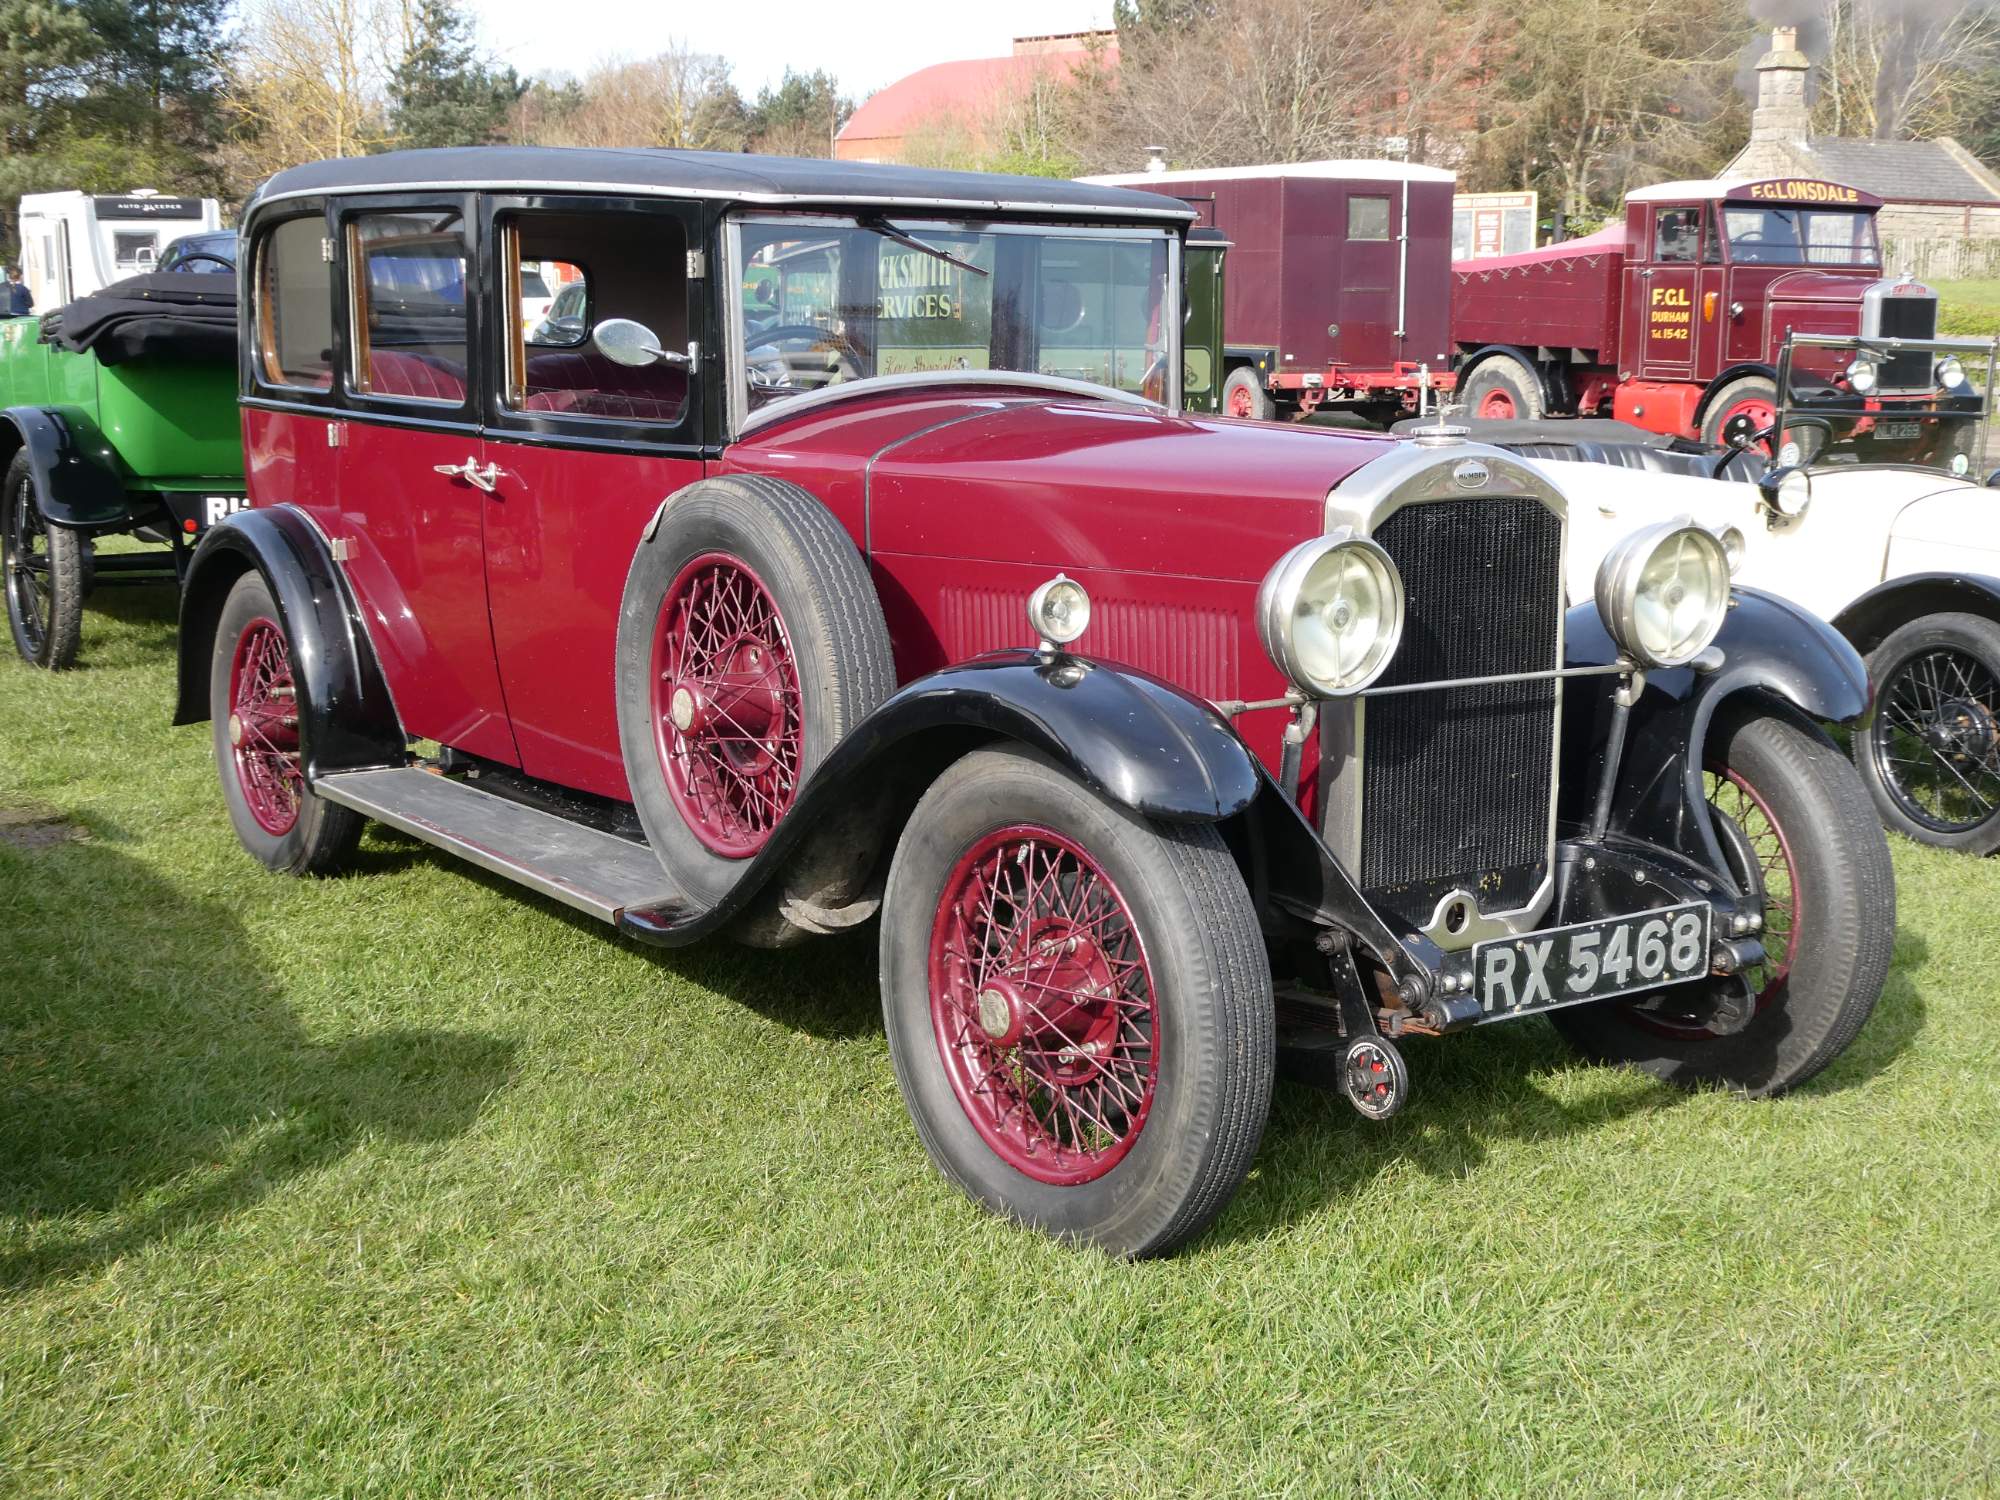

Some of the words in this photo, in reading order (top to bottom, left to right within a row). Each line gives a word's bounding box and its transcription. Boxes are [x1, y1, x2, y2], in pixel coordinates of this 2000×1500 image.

[1651, 311, 1689, 323] DURHAM
[1663, 328, 1688, 339] 1542
[1483, 940, 1554, 1012] RX
[1566, 913, 1702, 993] 5468
